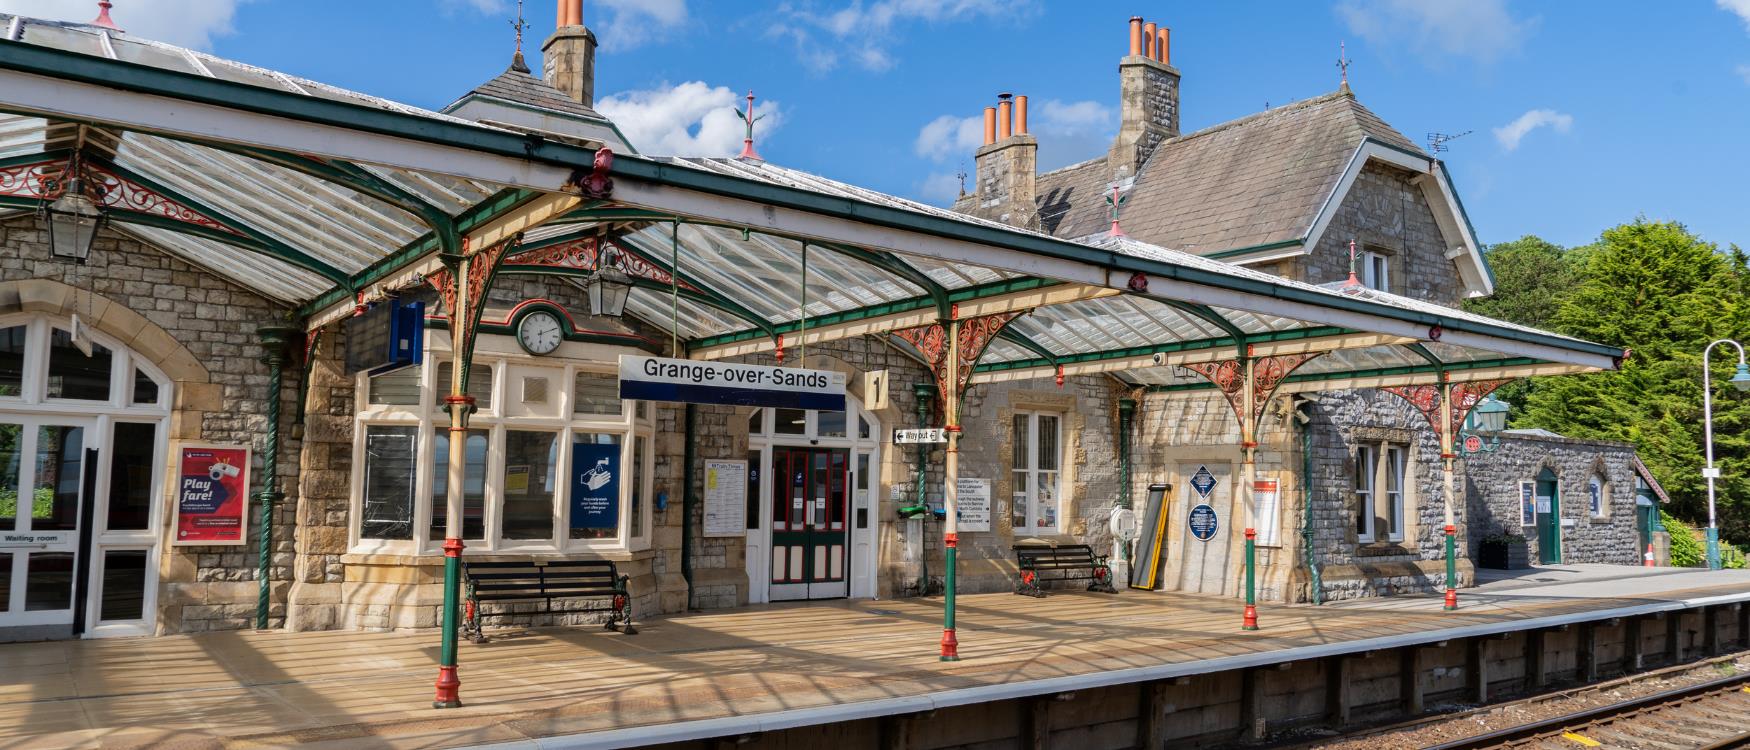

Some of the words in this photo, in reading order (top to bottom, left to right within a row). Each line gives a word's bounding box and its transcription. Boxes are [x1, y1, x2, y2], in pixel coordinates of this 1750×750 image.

[644, 358, 828, 388] Grange-over-Sands
[873, 376, 880, 403] 1
[905, 431, 918, 441] Way
[918, 431, 928, 439] out
[183, 478, 212, 492] Play
[181, 490, 213, 503] fare!
